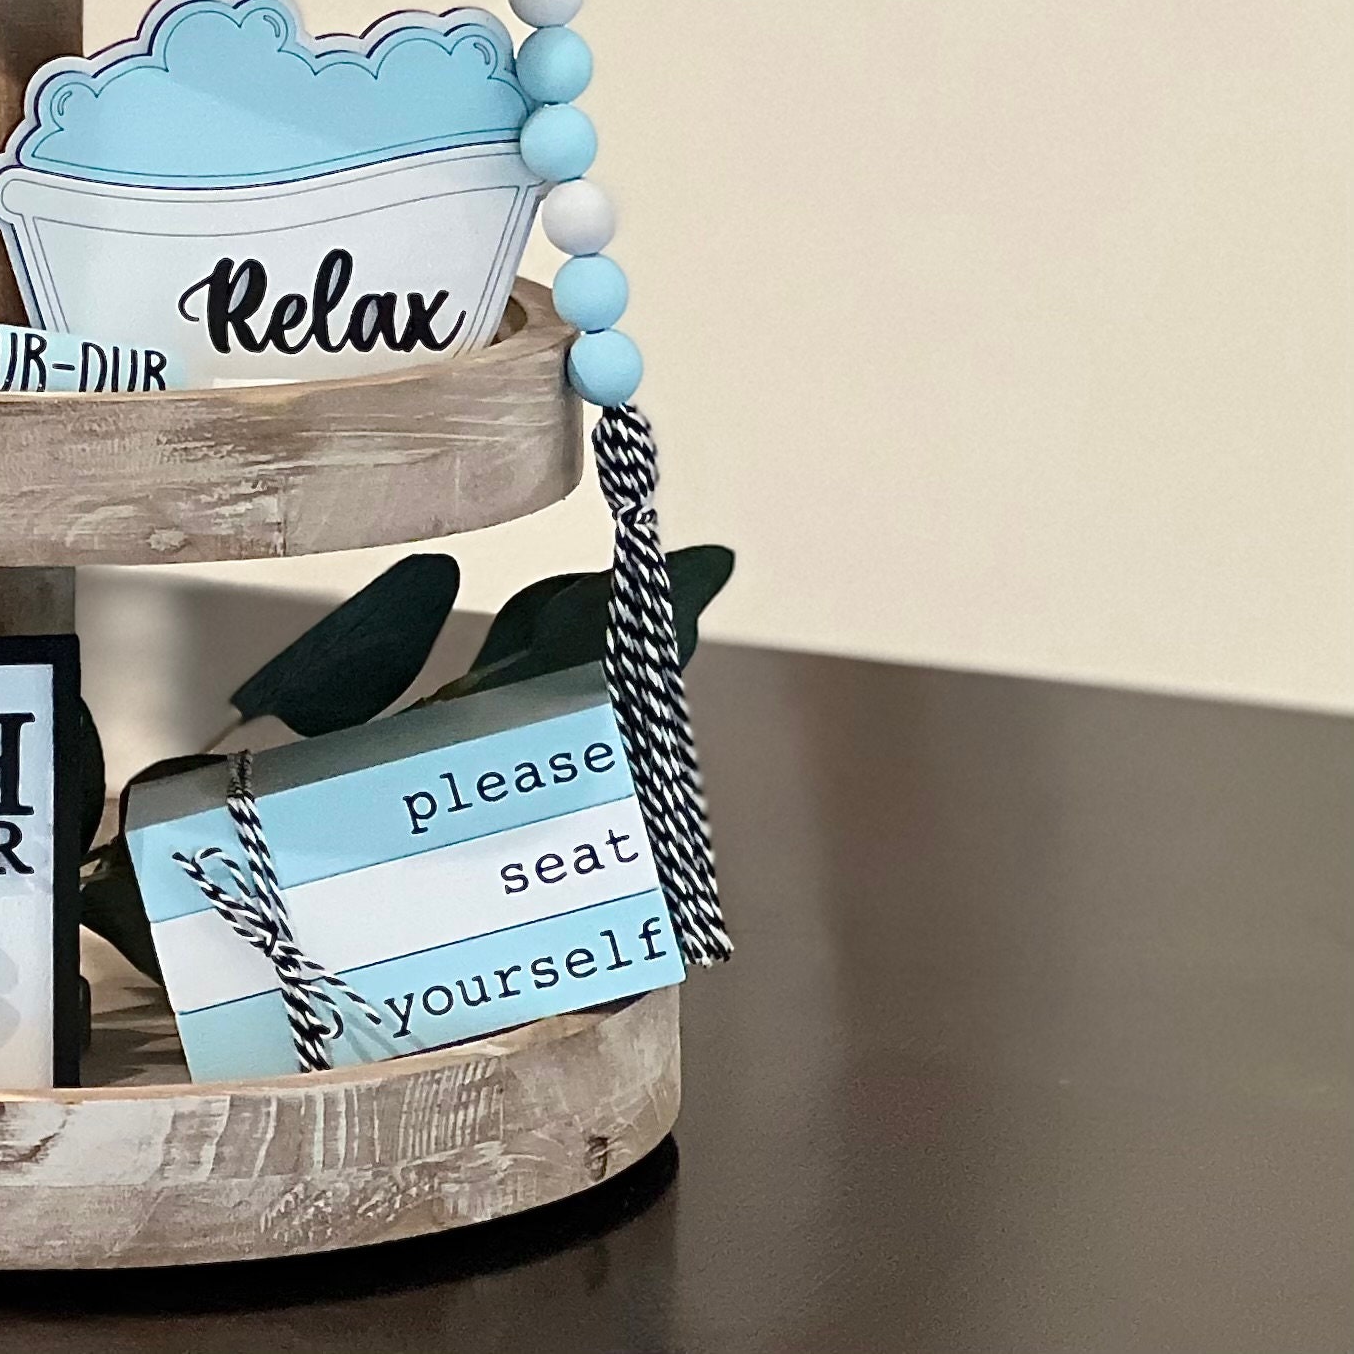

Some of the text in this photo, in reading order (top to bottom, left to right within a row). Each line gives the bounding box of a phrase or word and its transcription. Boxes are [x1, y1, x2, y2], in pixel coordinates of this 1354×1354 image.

[178, 248, 467, 354] Relax
[402, 741, 617, 835] please
[499, 829, 640, 895] seat
[383, 917, 668, 1039] yourself
